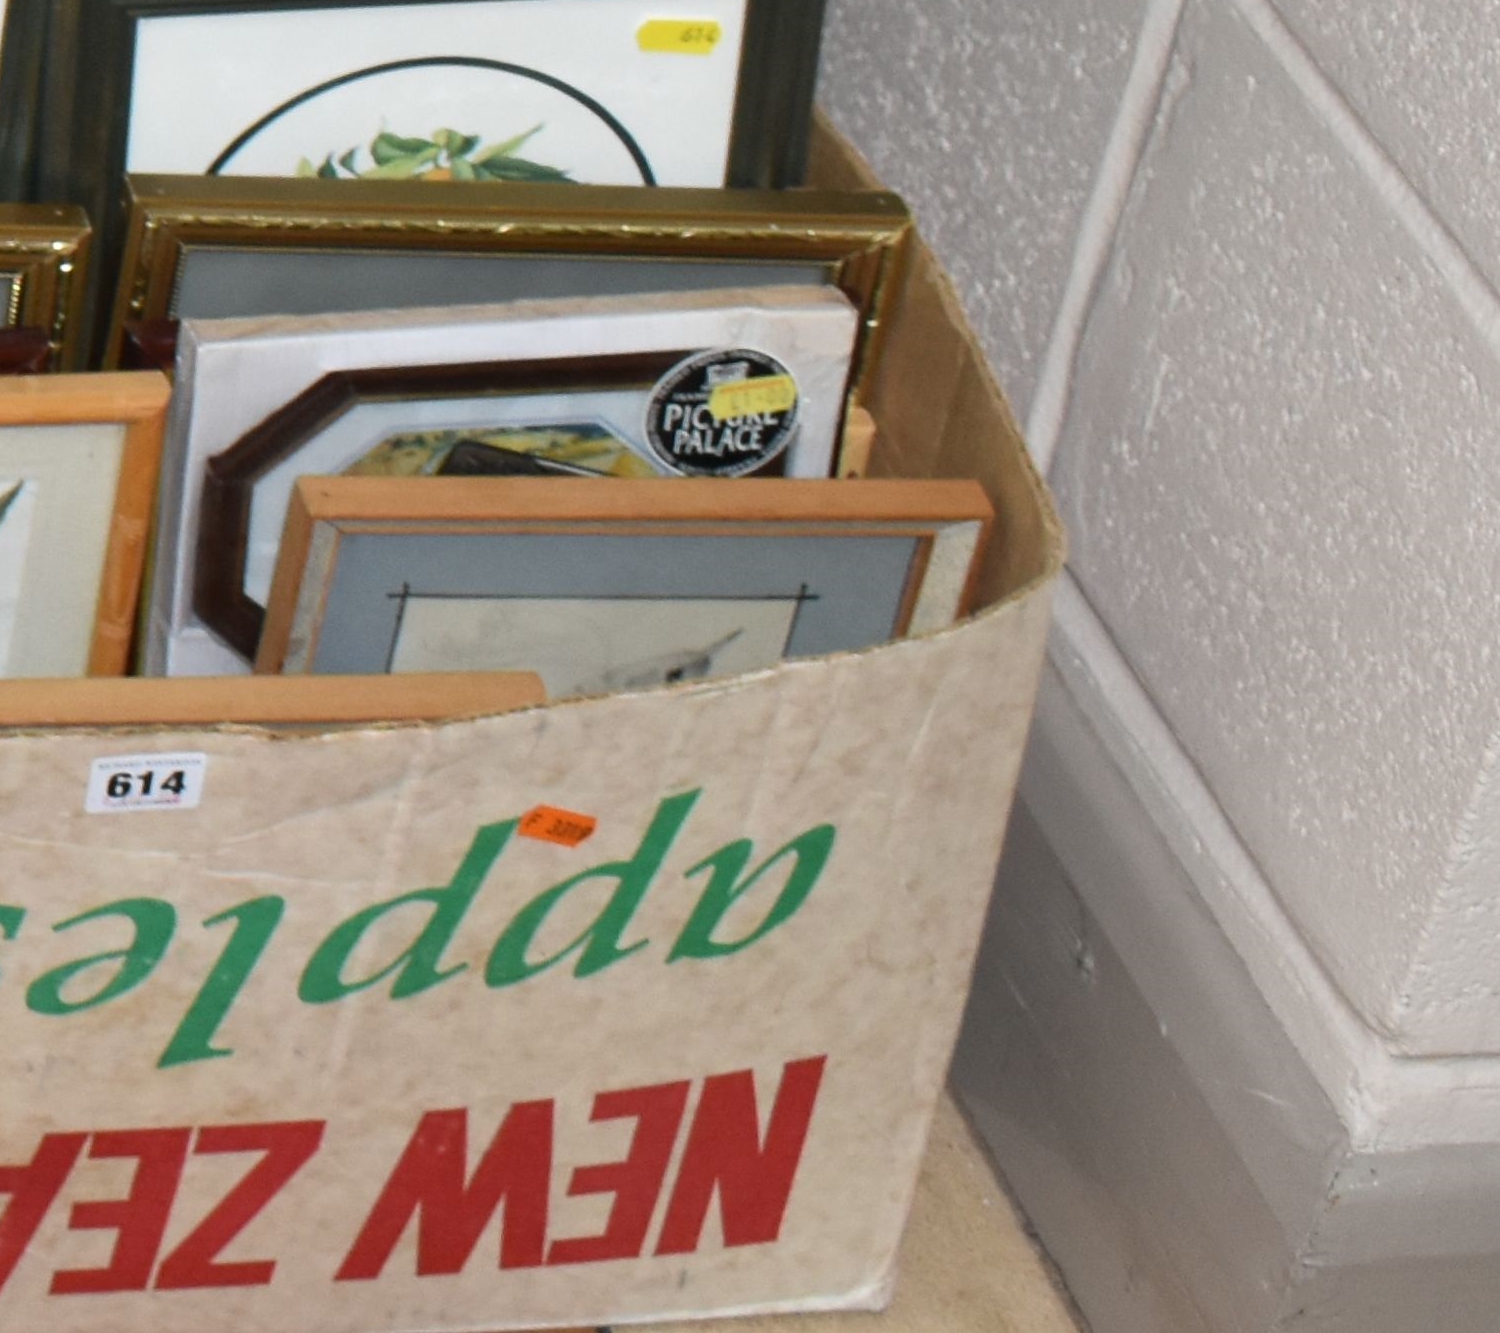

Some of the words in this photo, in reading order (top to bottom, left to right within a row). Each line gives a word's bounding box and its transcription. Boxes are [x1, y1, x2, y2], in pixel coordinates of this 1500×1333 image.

[672, 425, 764, 458] PALACE
[106, 769, 187, 799] 614
[334, 1053, 828, 1283] NEW
